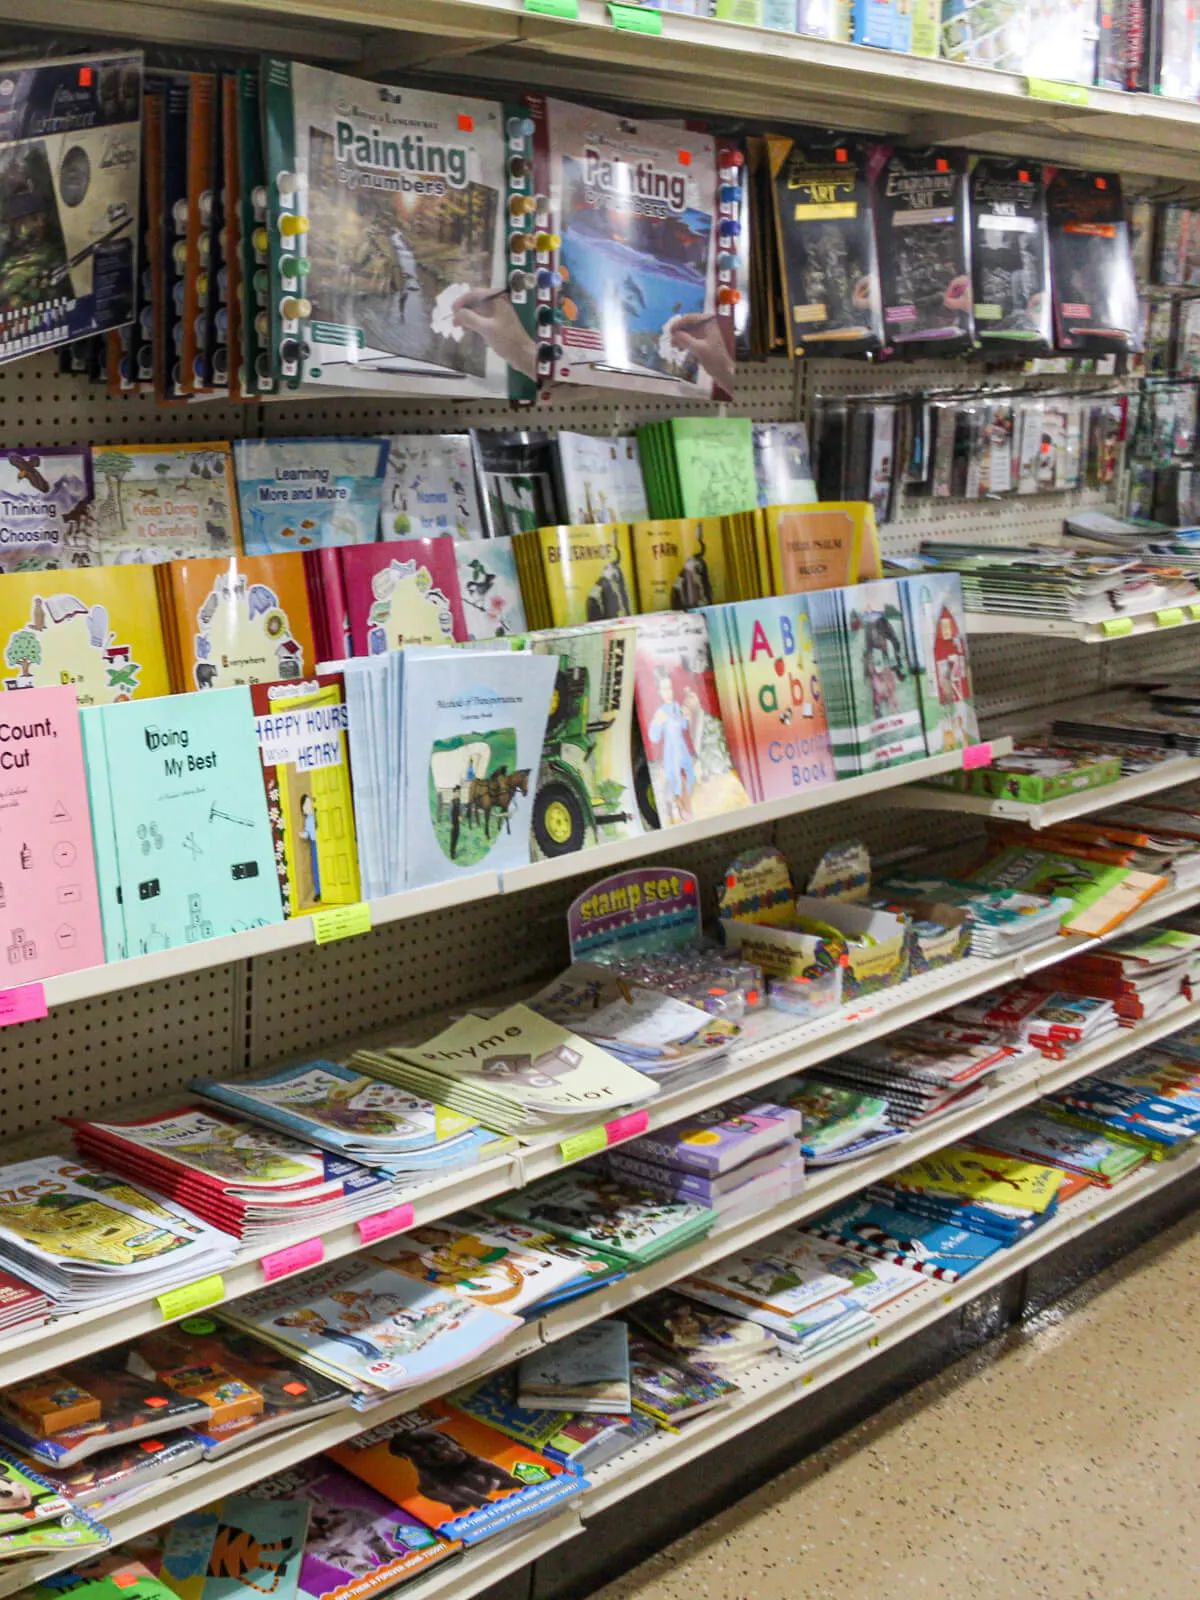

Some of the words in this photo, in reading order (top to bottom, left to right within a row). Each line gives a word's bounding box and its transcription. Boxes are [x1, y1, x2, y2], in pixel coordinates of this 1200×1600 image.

[337, 121, 466, 186] Painting
[361, 172, 446, 195] numbers
[275, 467, 329, 483] Learning
[260, 487, 289, 501] More
[291, 487, 313, 500] and
[316, 486, 347, 499] More
[3, 500, 57, 518] Thinking
[133, 502, 162, 517] Keep
[164, 501, 198, 517] Doing
[0, 527, 60, 545] Choosing
[750, 620, 775, 662] A
[780, 616, 796, 656] B
[758, 684, 779, 713] a
[788, 672, 805, 707] b
[307, 704, 349, 734] HOURS
[150, 727, 190, 751] Doing
[0, 749, 31, 770] Cut
[164, 757, 183, 778] My
[188, 751, 218, 772] Best
[298, 741, 341, 770] HENRY
[579, 881, 642, 923] stamp
[644, 875, 681, 898] set
[421, 1025, 525, 1062] Rhyme
